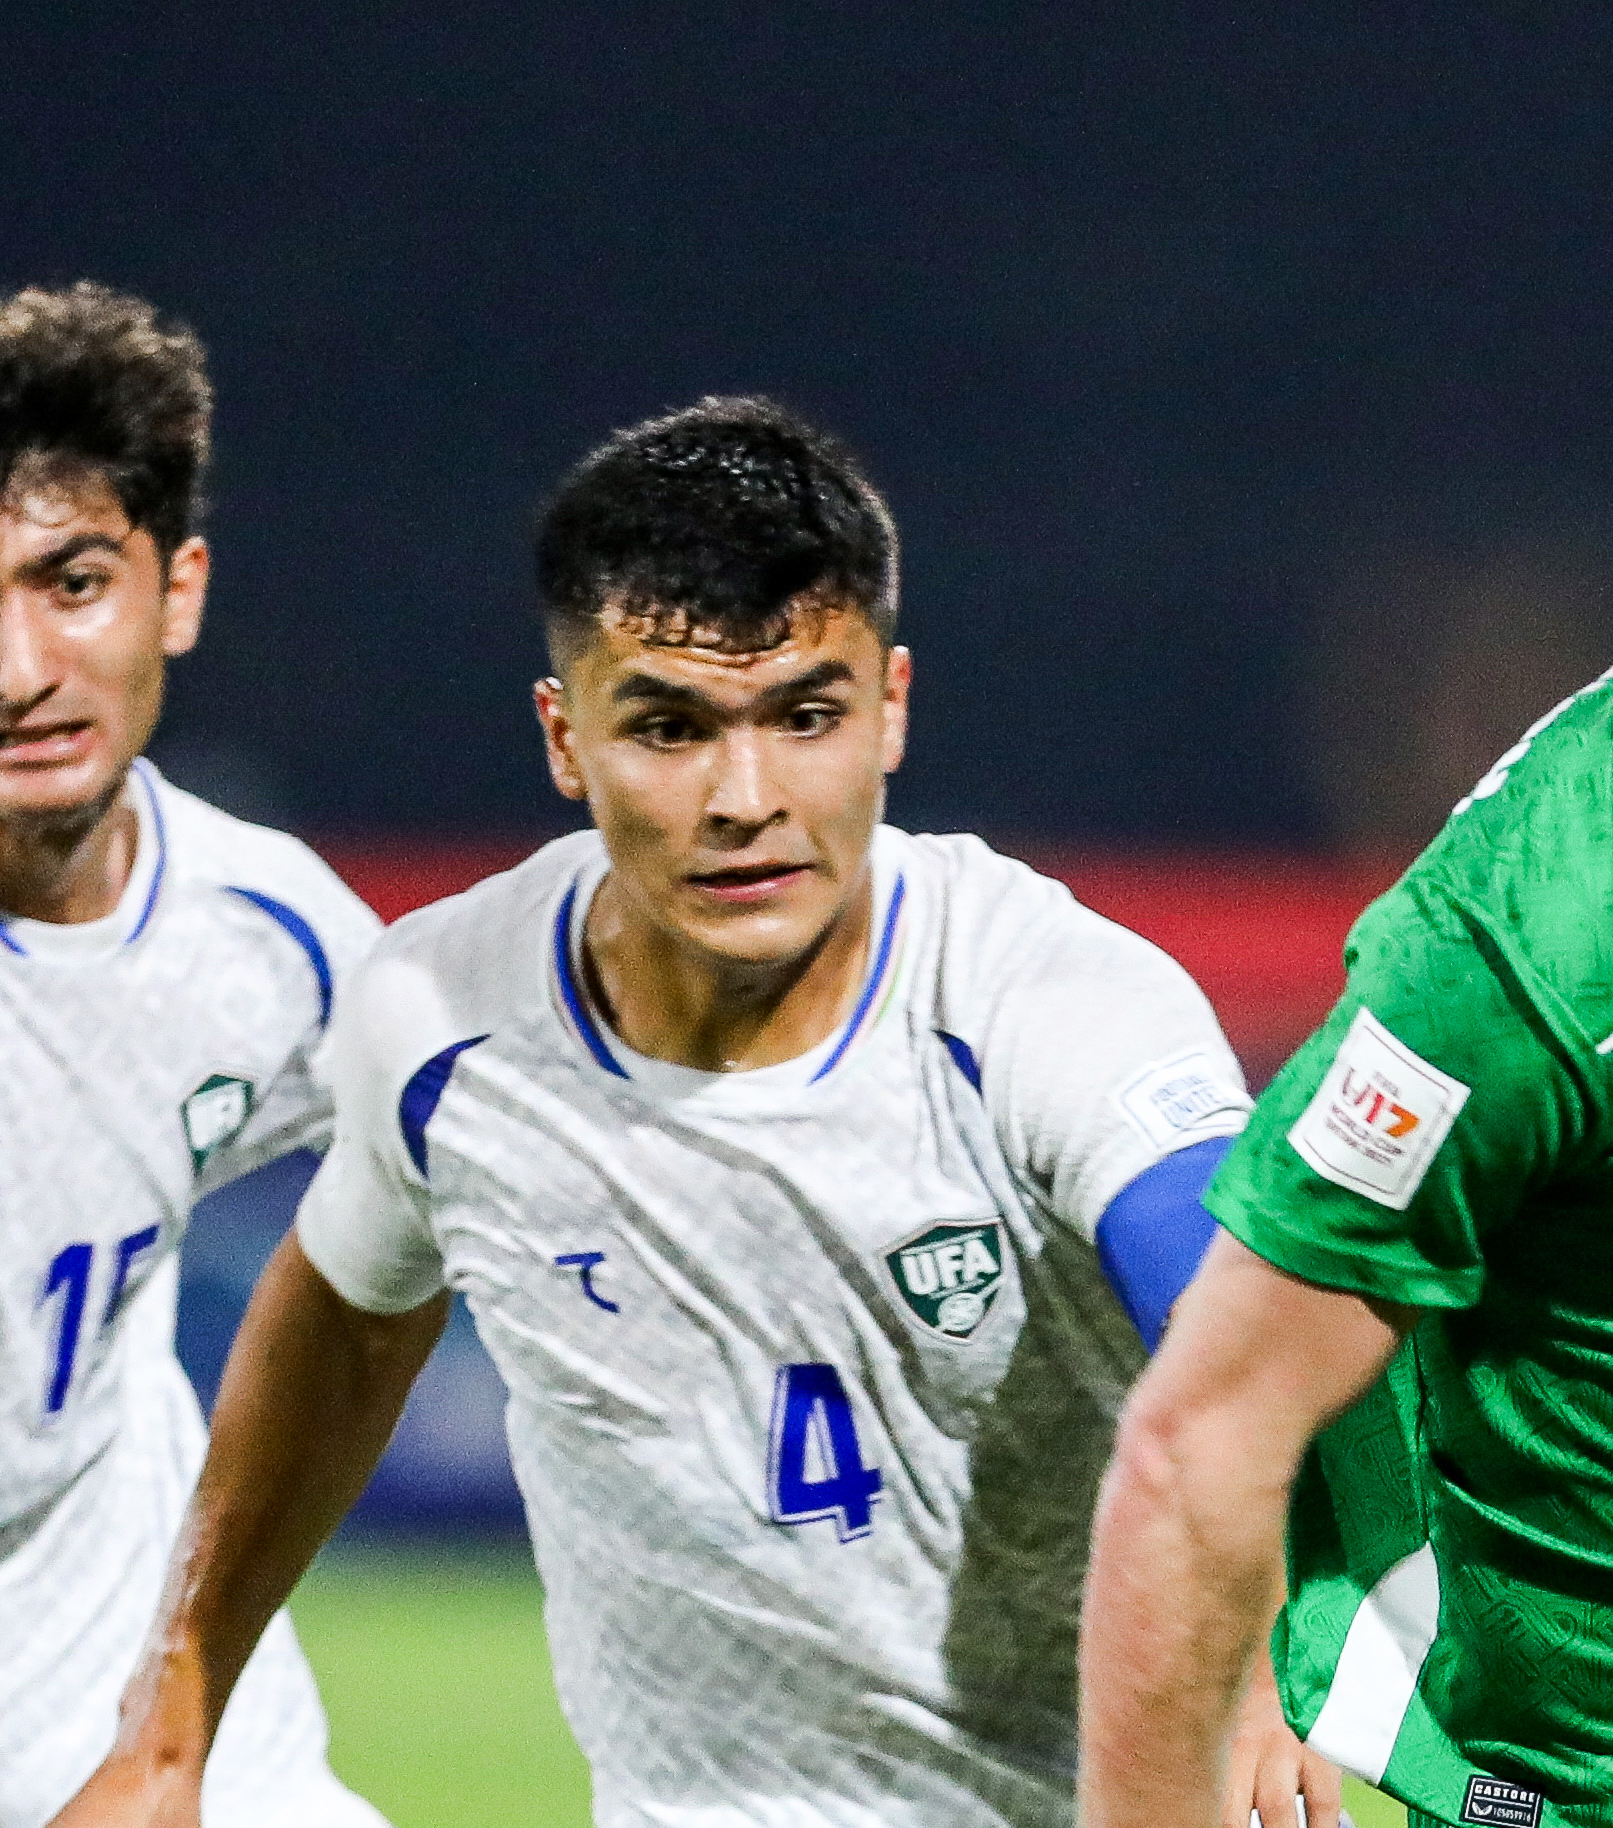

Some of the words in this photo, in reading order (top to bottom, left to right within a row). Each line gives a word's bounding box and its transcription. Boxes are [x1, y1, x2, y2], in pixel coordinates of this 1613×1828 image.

[900, 1238, 1000, 1295] UFA
[767, 1362, 882, 1544] 4
[1474, 1784, 1536, 1803] CASTORE
